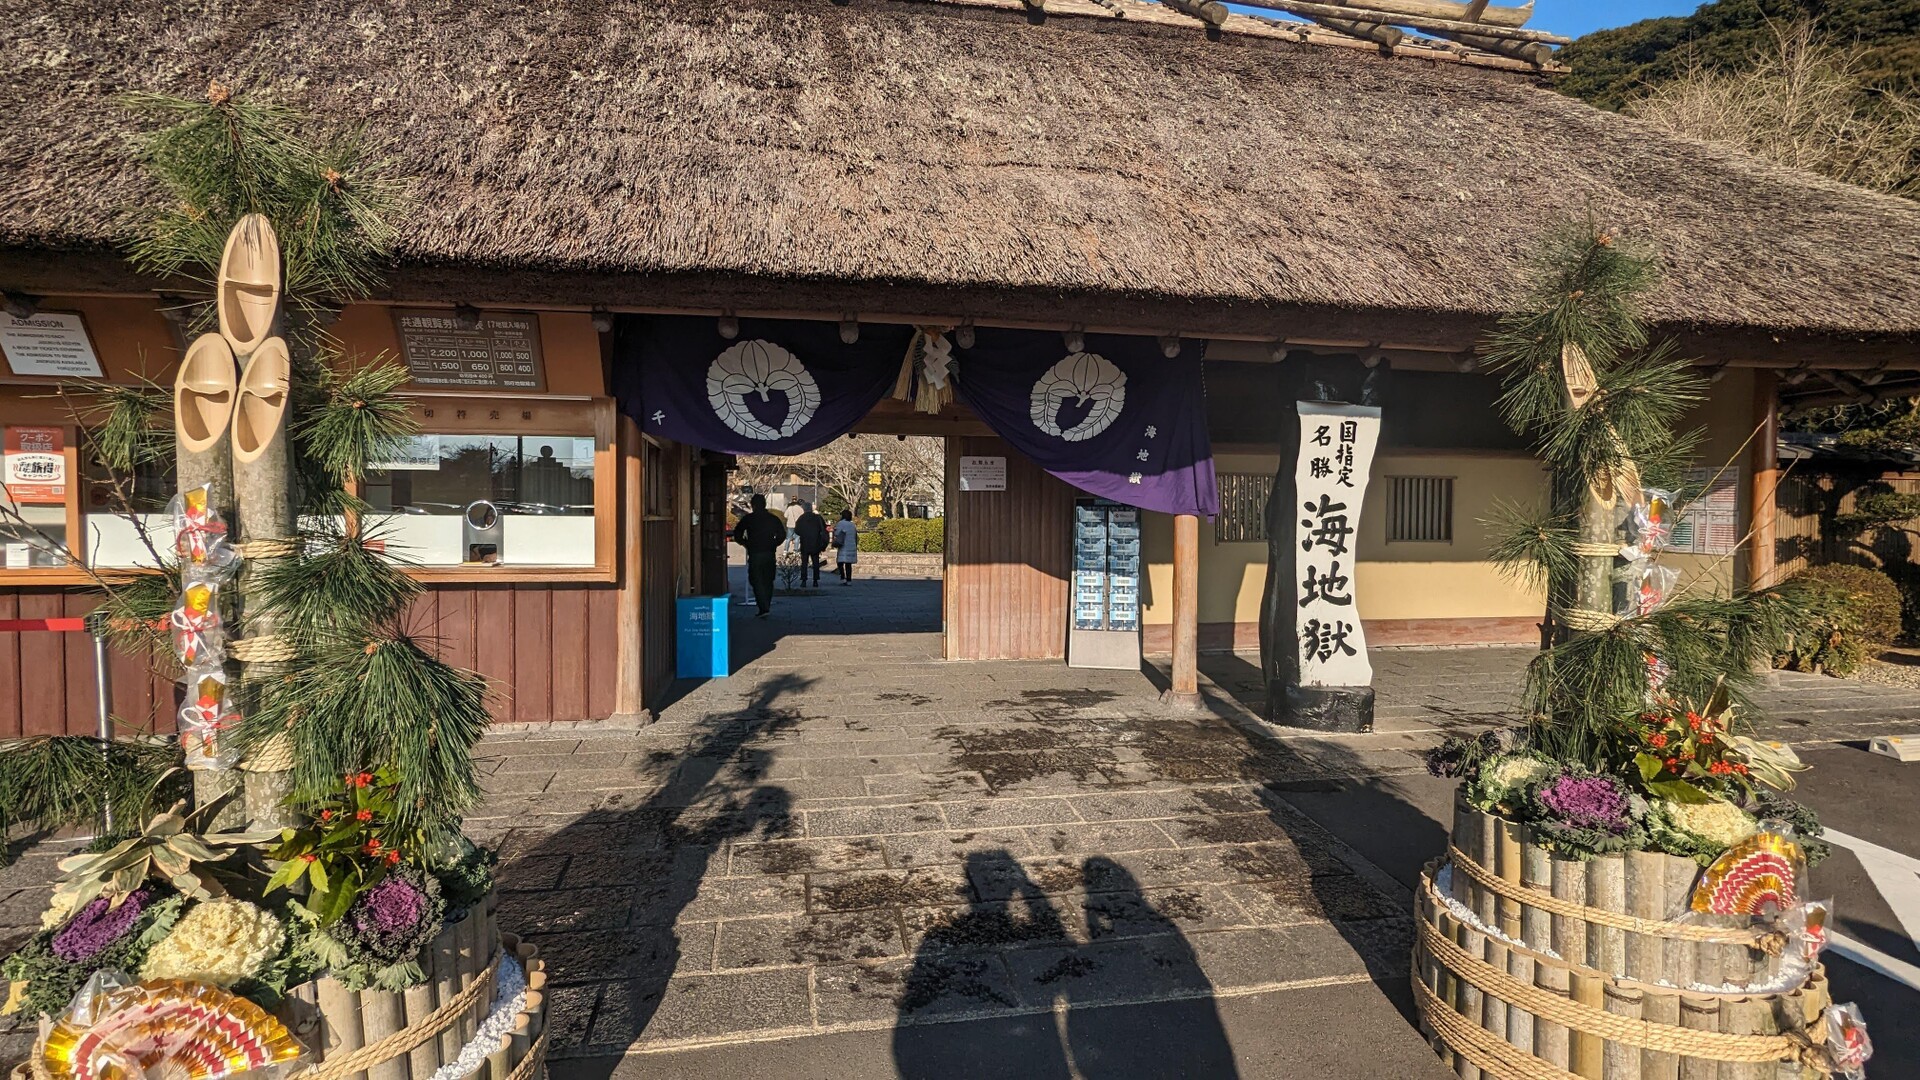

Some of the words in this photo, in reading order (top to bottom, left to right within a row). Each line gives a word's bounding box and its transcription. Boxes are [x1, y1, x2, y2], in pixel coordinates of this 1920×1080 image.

[11, 319, 64, 328] ADMISSION
[402, 316, 484, 330] 共通観覧券表
[462, 350, 488, 358] 1,000
[434, 362, 459, 370] 1,500
[424, 409, 532, 420] 切符売場
[651, 410, 666, 426] 千
[20, 434, 53, 442] クーポン
[1310, 424, 1334, 480] 名勝
[1334, 420, 1358, 488] 国指定
[868, 472, 882, 518] 海地獄
[1298, 493, 1357, 664] 海地獄
